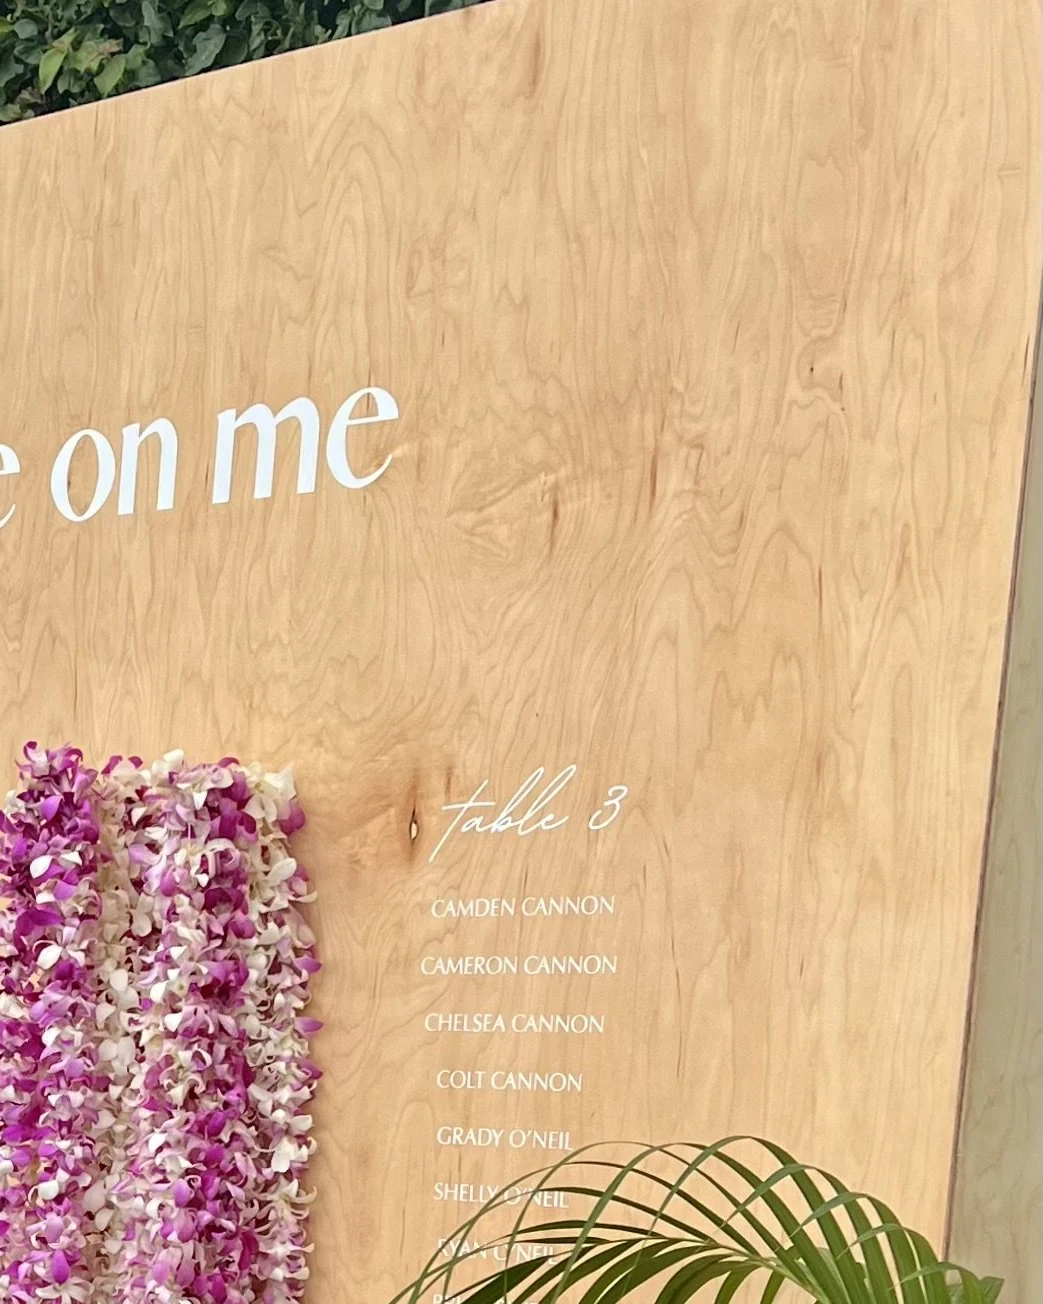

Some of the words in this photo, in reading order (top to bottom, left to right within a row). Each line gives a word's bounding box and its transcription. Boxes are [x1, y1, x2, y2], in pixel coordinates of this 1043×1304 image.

[50, 417, 179, 523] on
[212, 386, 399, 504] me
[428, 764, 577, 863] table
[588, 785, 628, 830] 3
[431, 897, 516, 918] CAMDEN
[521, 895, 616, 917] CANNON
[420, 956, 517, 976] CAMERON
[523, 955, 618, 975] CANNON
[424, 1012, 506, 1033] CHELSEA
[511, 1013, 604, 1033] CANNON
[436, 1069, 486, 1089] COLT
[490, 1071, 583, 1092] CANNON
[436, 1126, 504, 1147] GRADY
[509, 1128, 574, 1150] O'NEIL
[433, 1182, 499, 1204] SHELLY
[503, 1186, 569, 1209] O'NEIL
